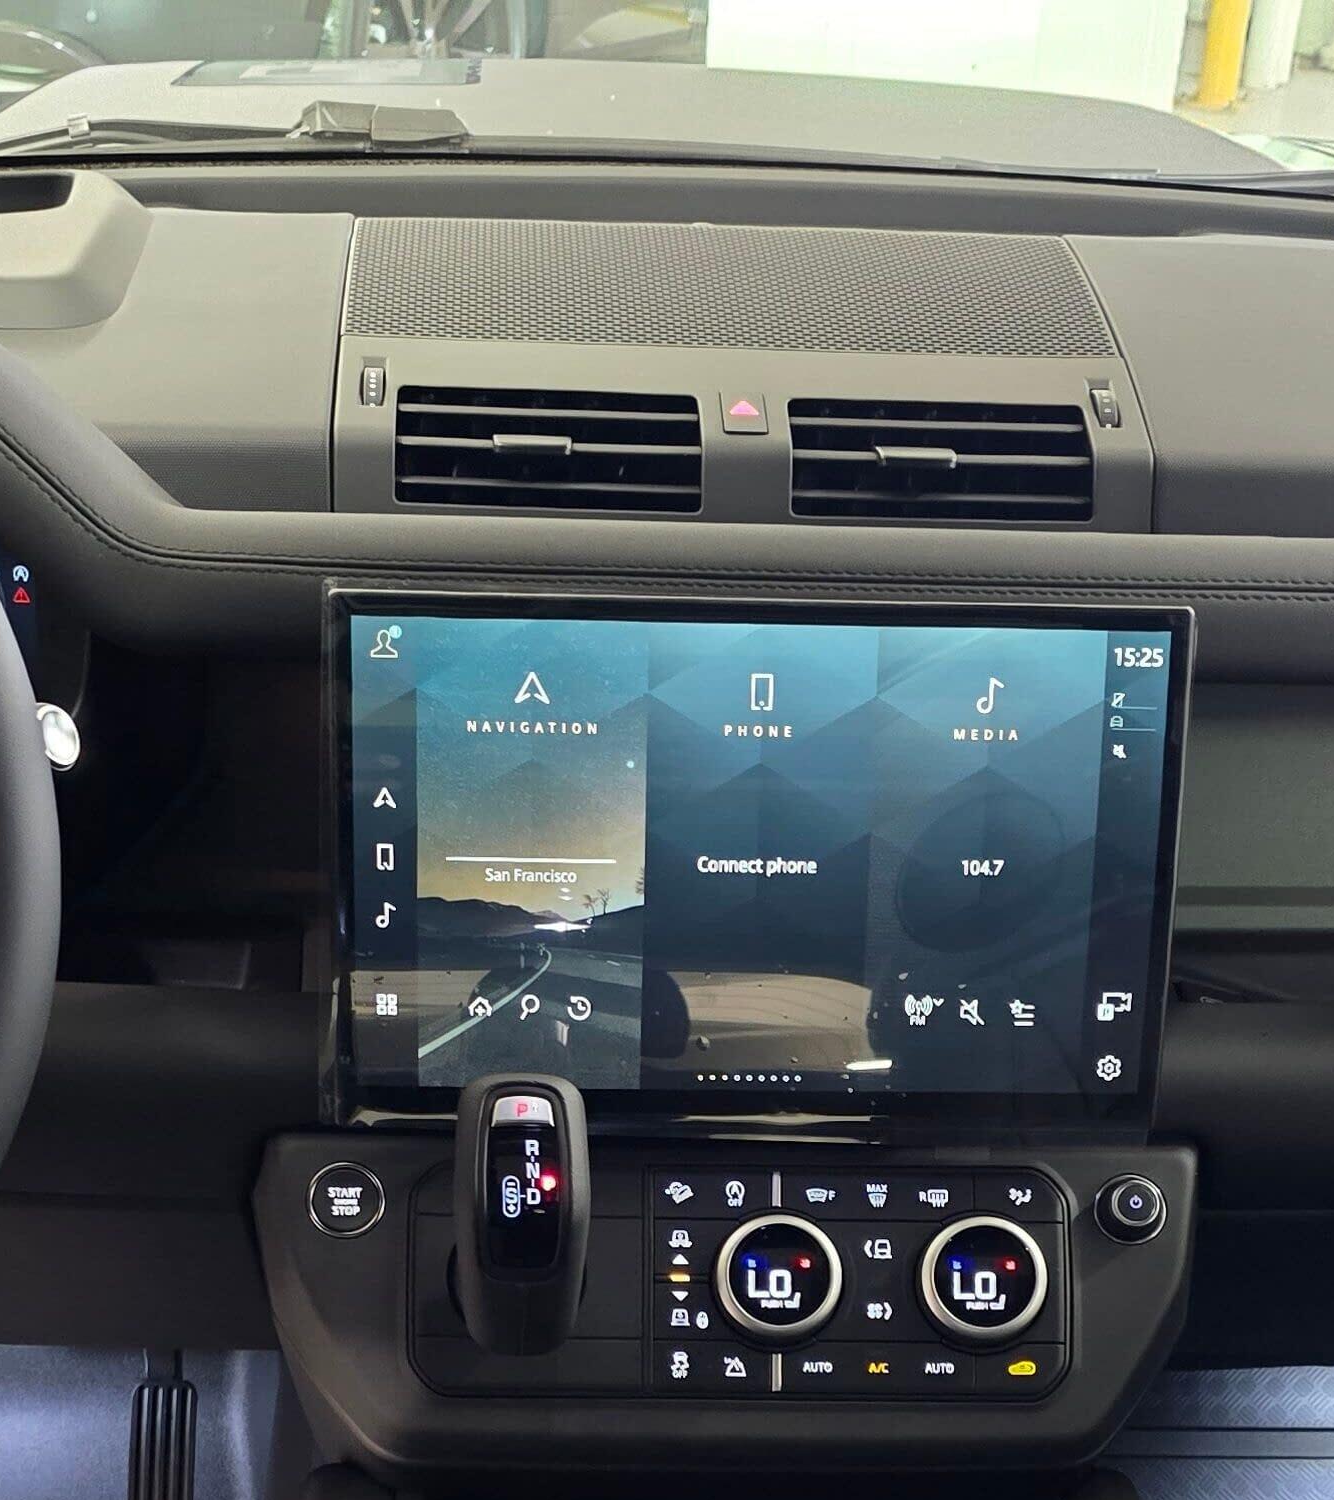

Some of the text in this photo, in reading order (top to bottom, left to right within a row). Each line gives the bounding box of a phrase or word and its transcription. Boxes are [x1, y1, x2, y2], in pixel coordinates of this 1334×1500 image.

[1114, 647, 1164, 668] 15:25
[466, 720, 598, 735] NAVIGATION
[723, 725, 793, 738] PHONE
[953, 728, 1018, 741] MEDIA
[696, 855, 818, 878] Connect phone
[961, 858, 1005, 877] 104.7
[484, 867, 577, 884] San Francisco
[909, 1015, 926, 1026] FM
[517, 1103, 528, 1117] P
[525, 1139, 540, 1156] R
[526, 1162, 540, 1179] N
[327, 1186, 363, 1198] START
[866, 1184, 888, 1193] MAX
[505, 1187, 518, 1205] S
[526, 1188, 541, 1205] D
[828, 1190, 836, 1201] F
[919, 1191, 927, 1202] R
[727, 1198, 743, 1208] OFF
[331, 1205, 361, 1216] STOP
[748, 1268, 792, 1299] LO
[953, 1271, 997, 1301] LO
[802, 1361, 833, 1374] AUTO
[868, 1362, 890, 1374] A/C
[924, 1362, 955, 1375] AUTO
[672, 1370, 688, 1379] OFF
